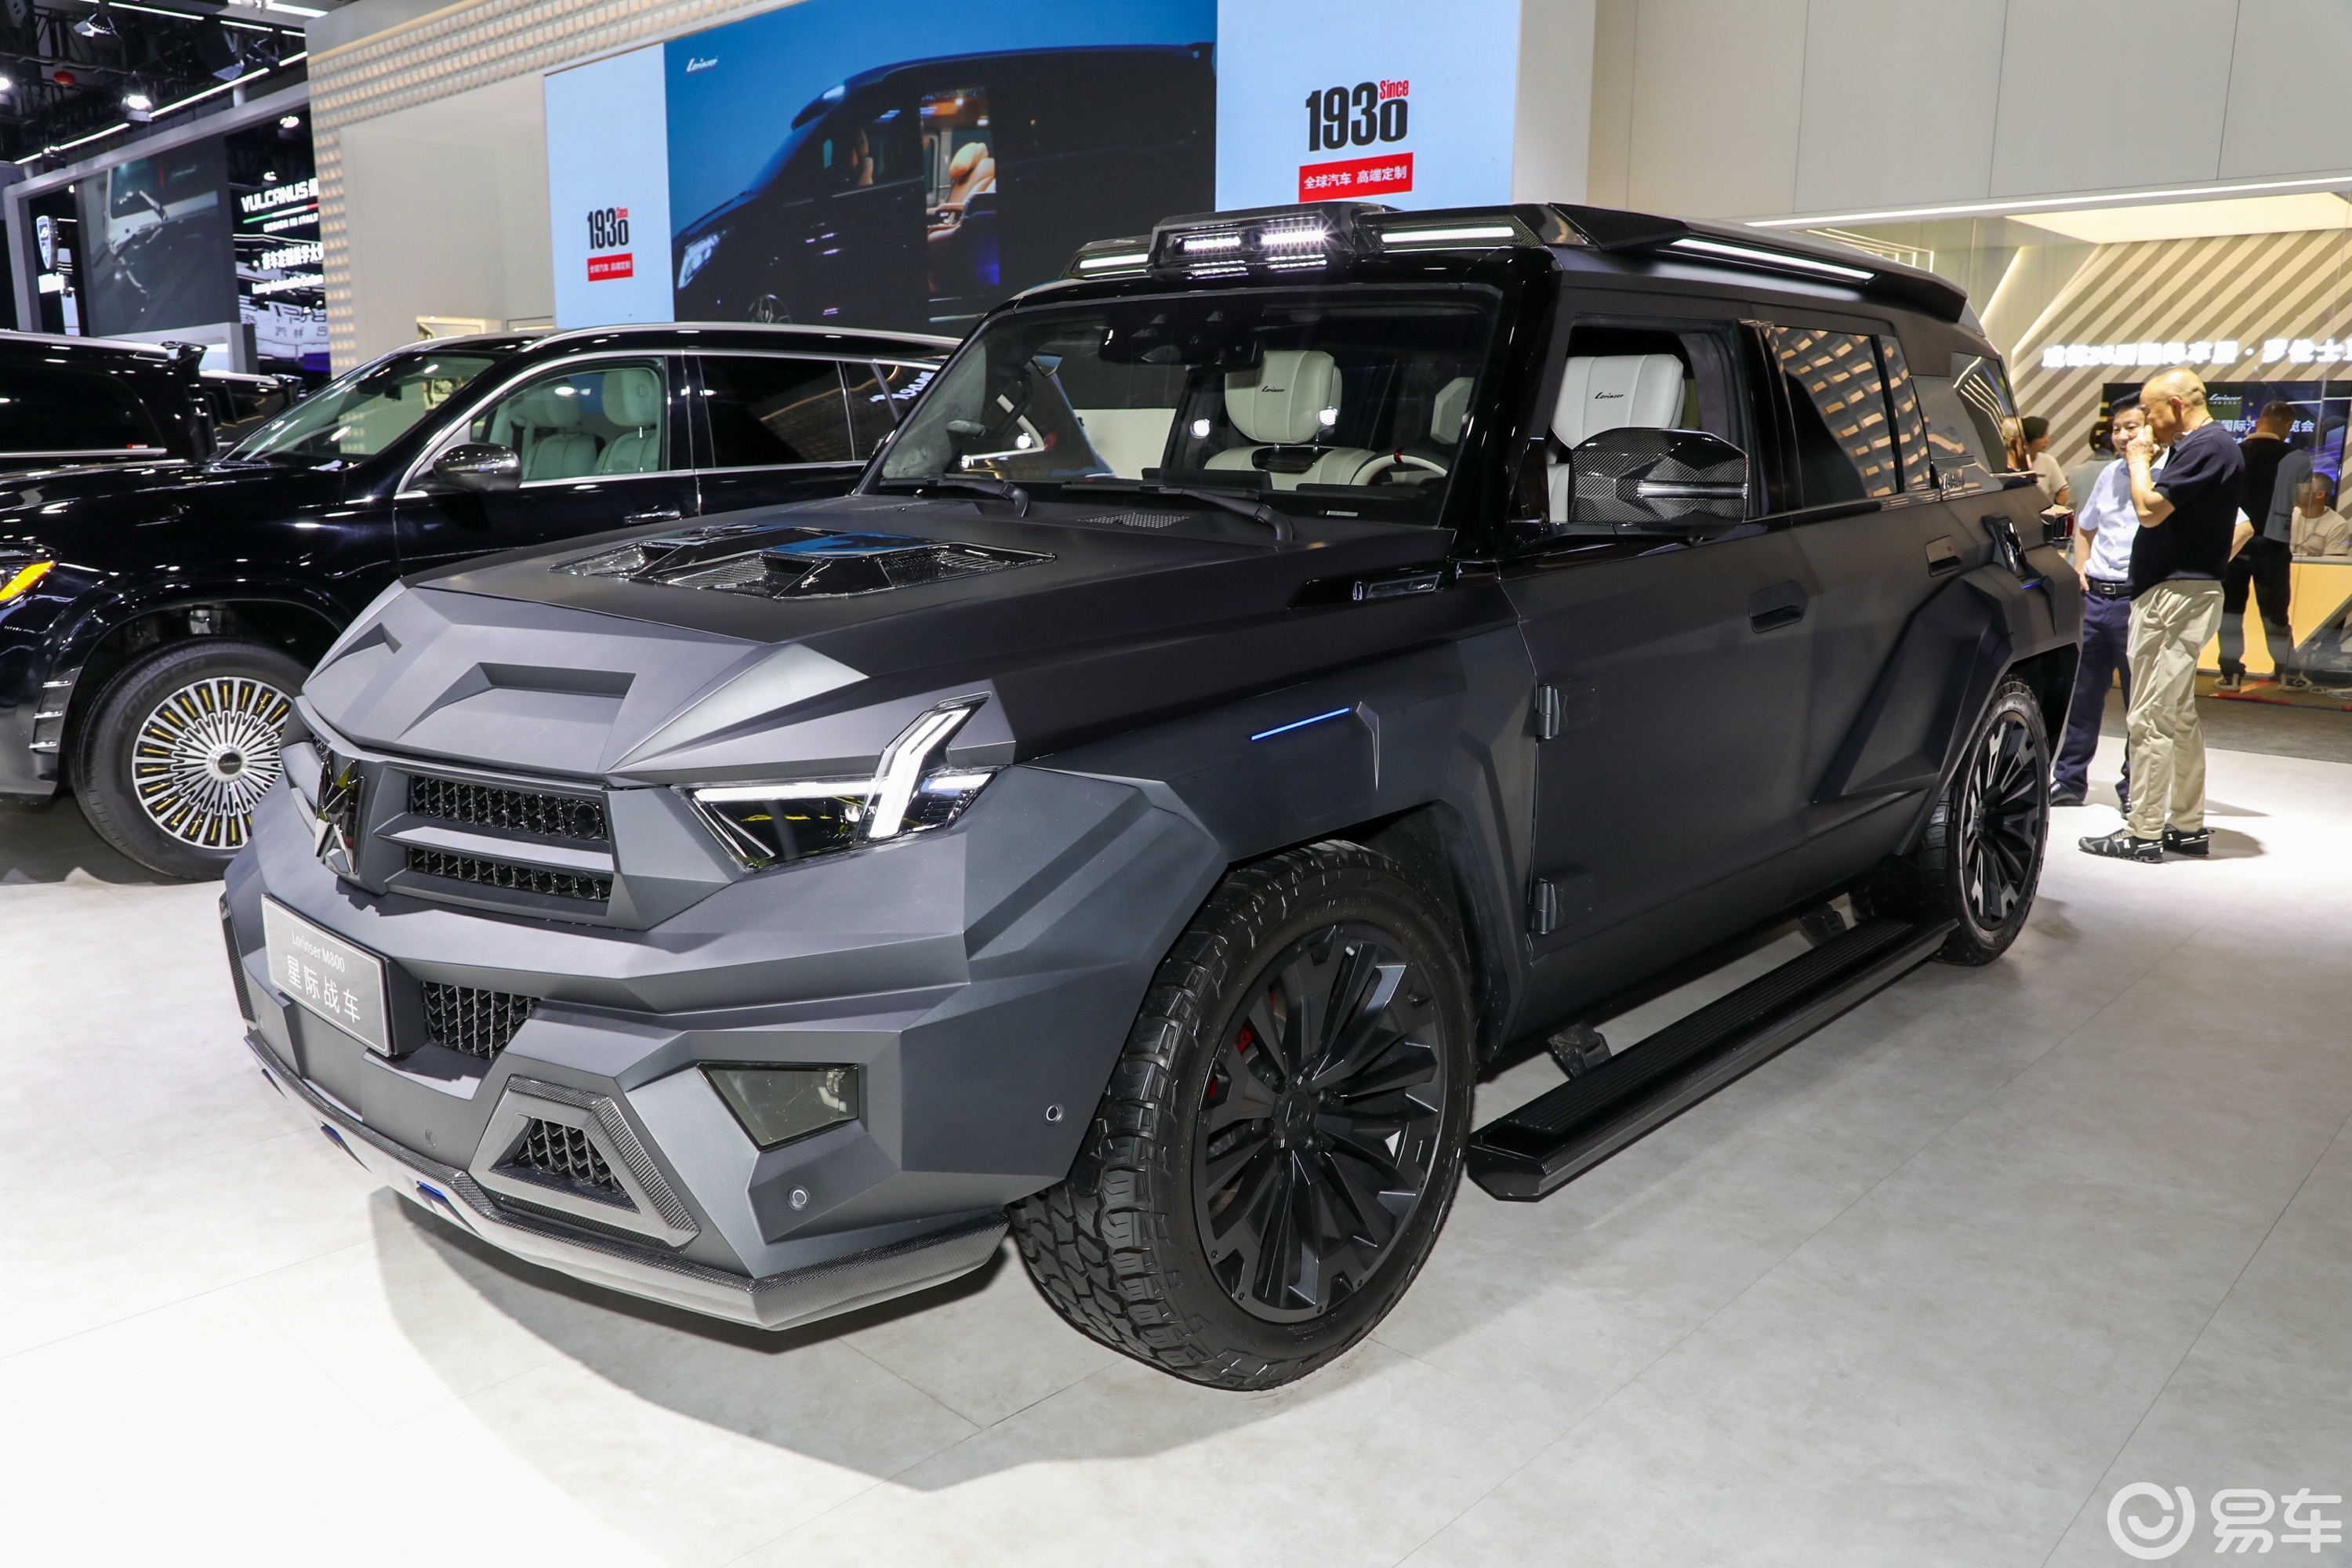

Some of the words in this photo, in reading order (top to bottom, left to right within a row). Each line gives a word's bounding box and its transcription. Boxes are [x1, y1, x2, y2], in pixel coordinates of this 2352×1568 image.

[1379, 79, 1410, 100] Since
[1305, 82, 1408, 152] 1930
[1304, 172, 1352, 190] 全球汽车
[1356, 165, 1407, 184] 高端定制
[587, 207, 630, 249] 1930
[292, 930, 321, 959] Lorinser
[322, 947, 345, 972] M800
[287, 954, 361, 1023] 星际战车
